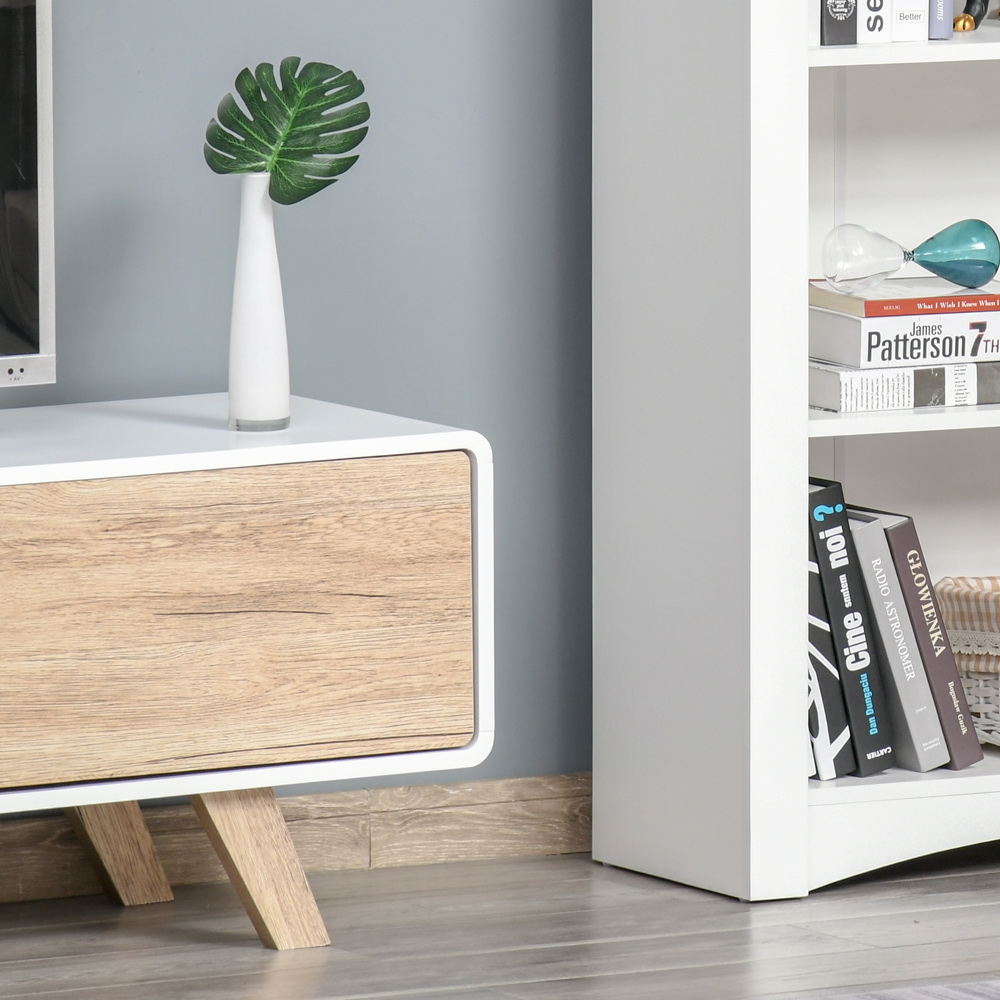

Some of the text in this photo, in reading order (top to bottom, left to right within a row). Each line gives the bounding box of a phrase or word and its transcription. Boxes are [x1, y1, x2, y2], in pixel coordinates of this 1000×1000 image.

[900, 12, 921, 21] Better
[909, 322, 942, 337] James
[867, 331, 966, 362] Patterson
[813, 504, 843, 522] ?
[819, 525, 849, 570] noi
[872, 558, 915, 682] RADIO ASTRONOMER
[843, 611, 871, 672] Cine
[860, 672, 878, 736] Dan Dungaciu
[957, 714, 968, 735] Guzik
[866, 746, 892, 760] CARTIER
